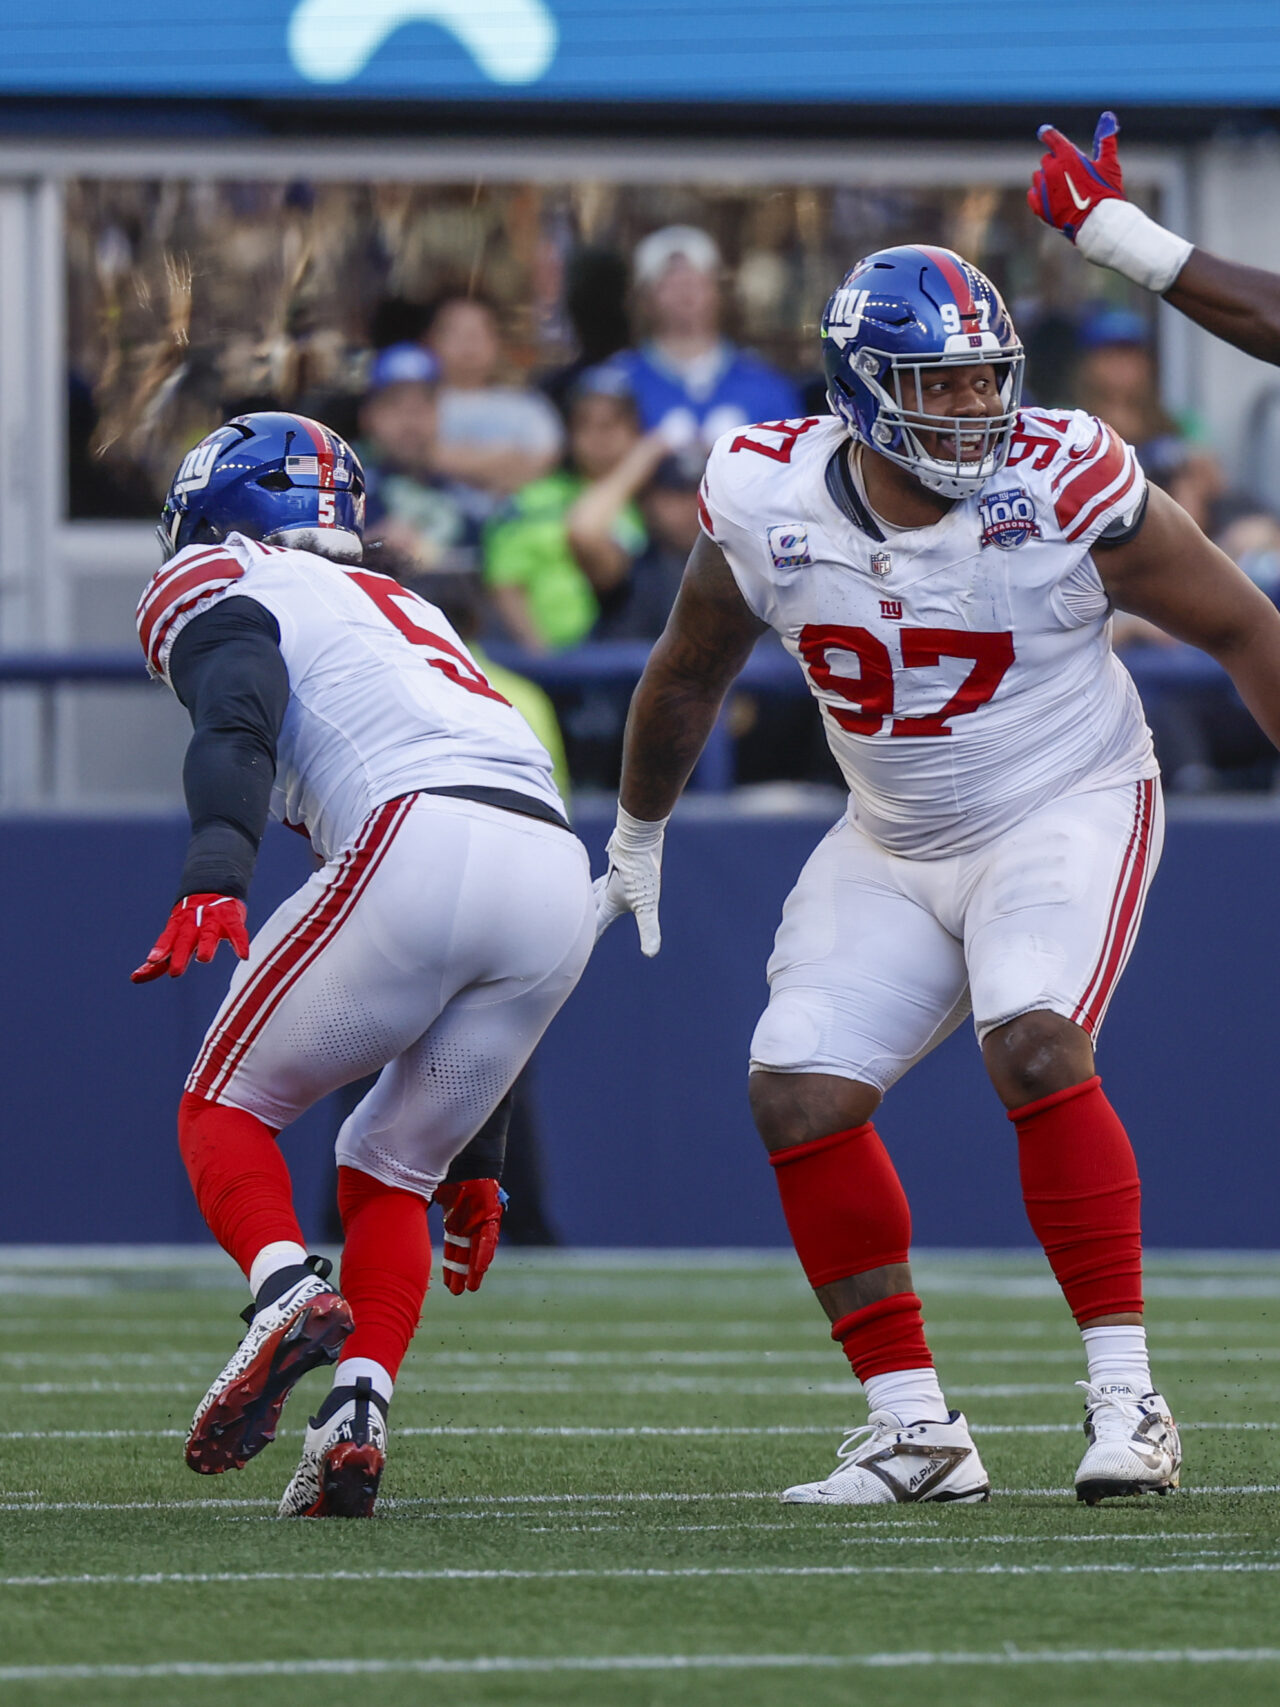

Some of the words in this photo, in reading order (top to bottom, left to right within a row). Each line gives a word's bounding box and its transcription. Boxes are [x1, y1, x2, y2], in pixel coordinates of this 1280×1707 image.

[318, 492, 336, 525] 5
[979, 497, 1035, 530] 100
[986, 521, 1032, 536] SEASONS
[346, 571, 513, 708] 5
[799, 624, 1015, 738] 97
[908, 1459, 943, 1491] ALPHA
